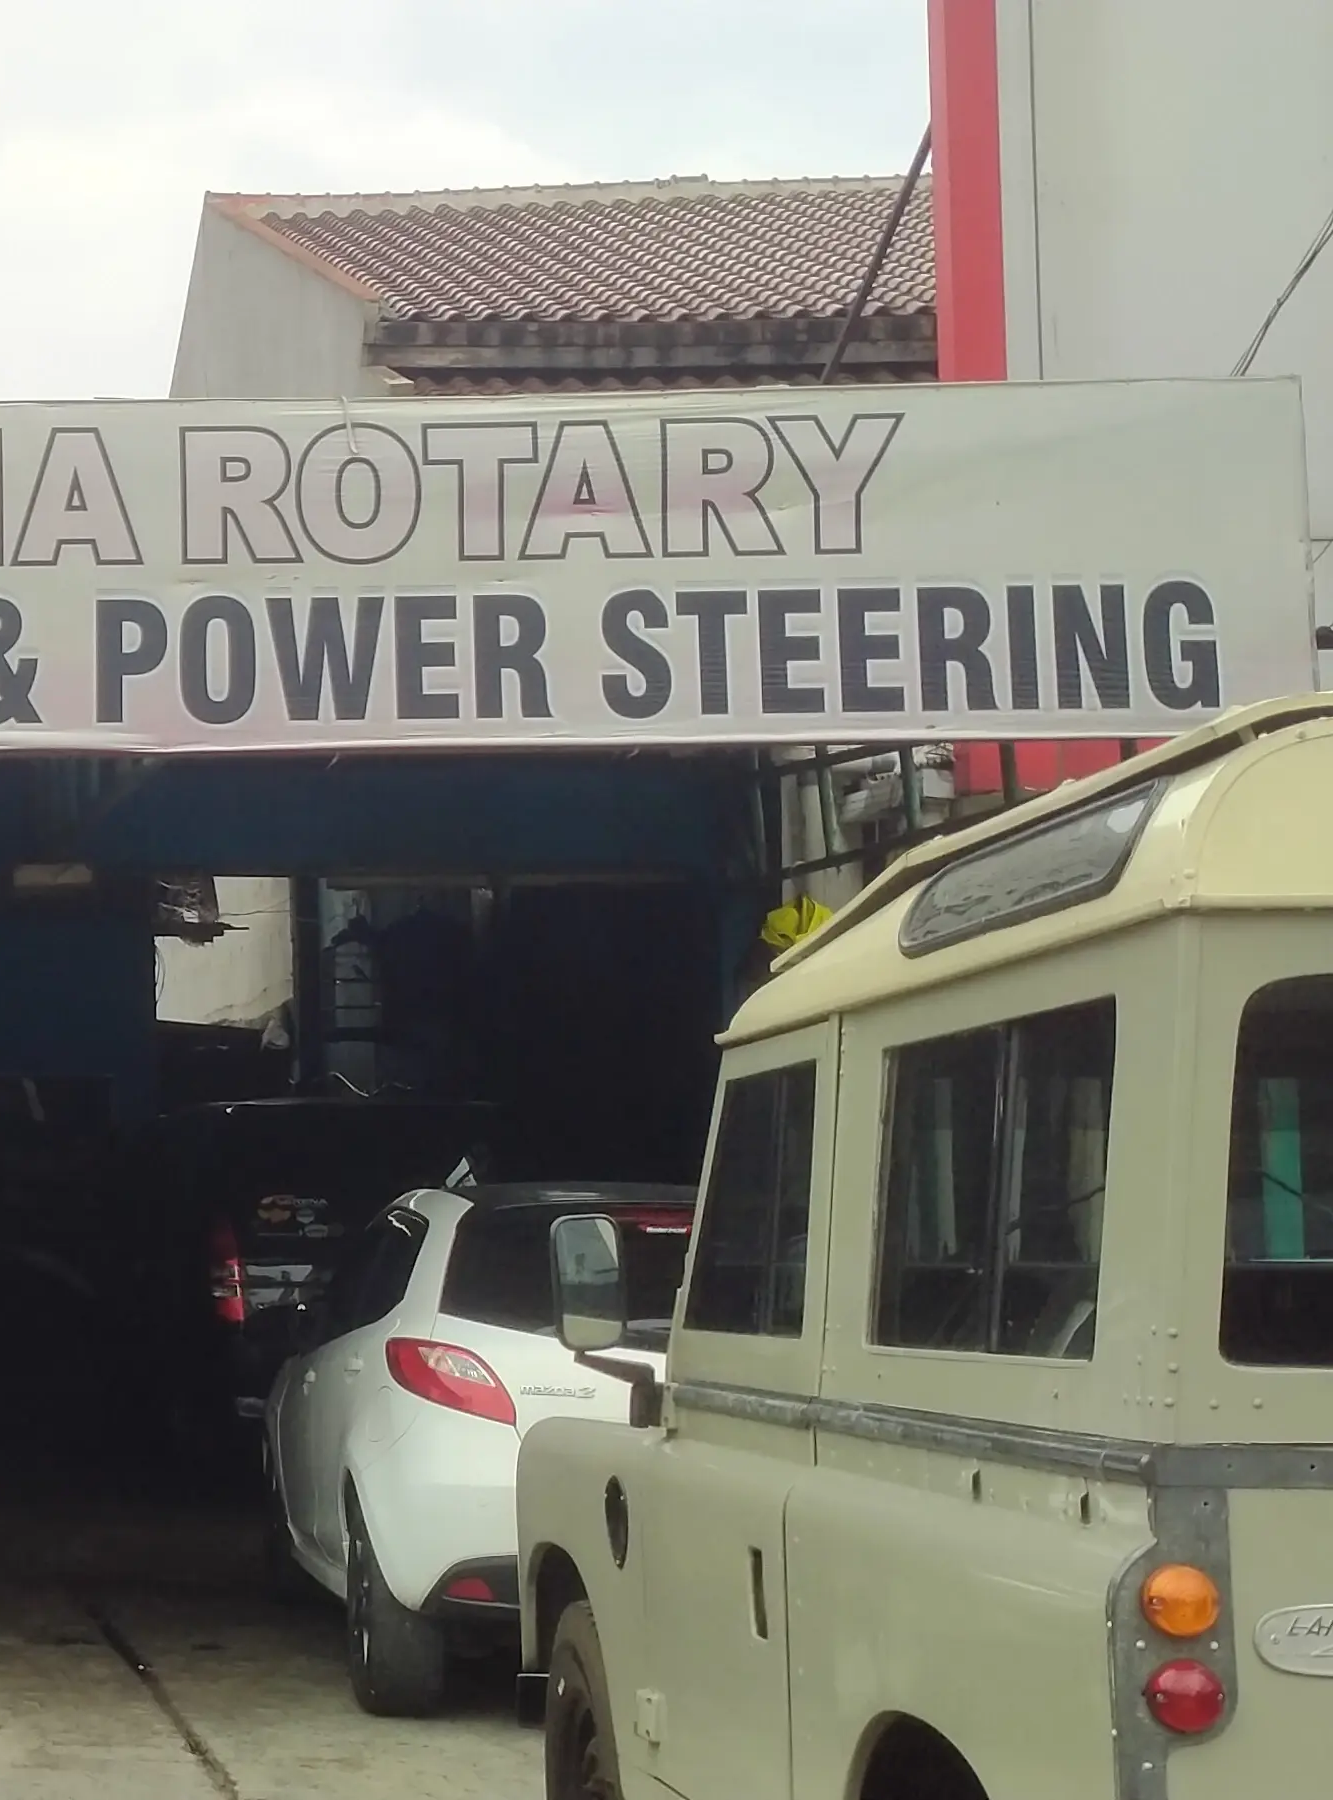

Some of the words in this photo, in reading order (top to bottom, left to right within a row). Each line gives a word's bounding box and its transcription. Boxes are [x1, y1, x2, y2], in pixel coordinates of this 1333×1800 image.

[179, 412, 906, 568] ROTARY
[95, 593, 554, 724] POWER
[600, 581, 1221, 718] STEERING
